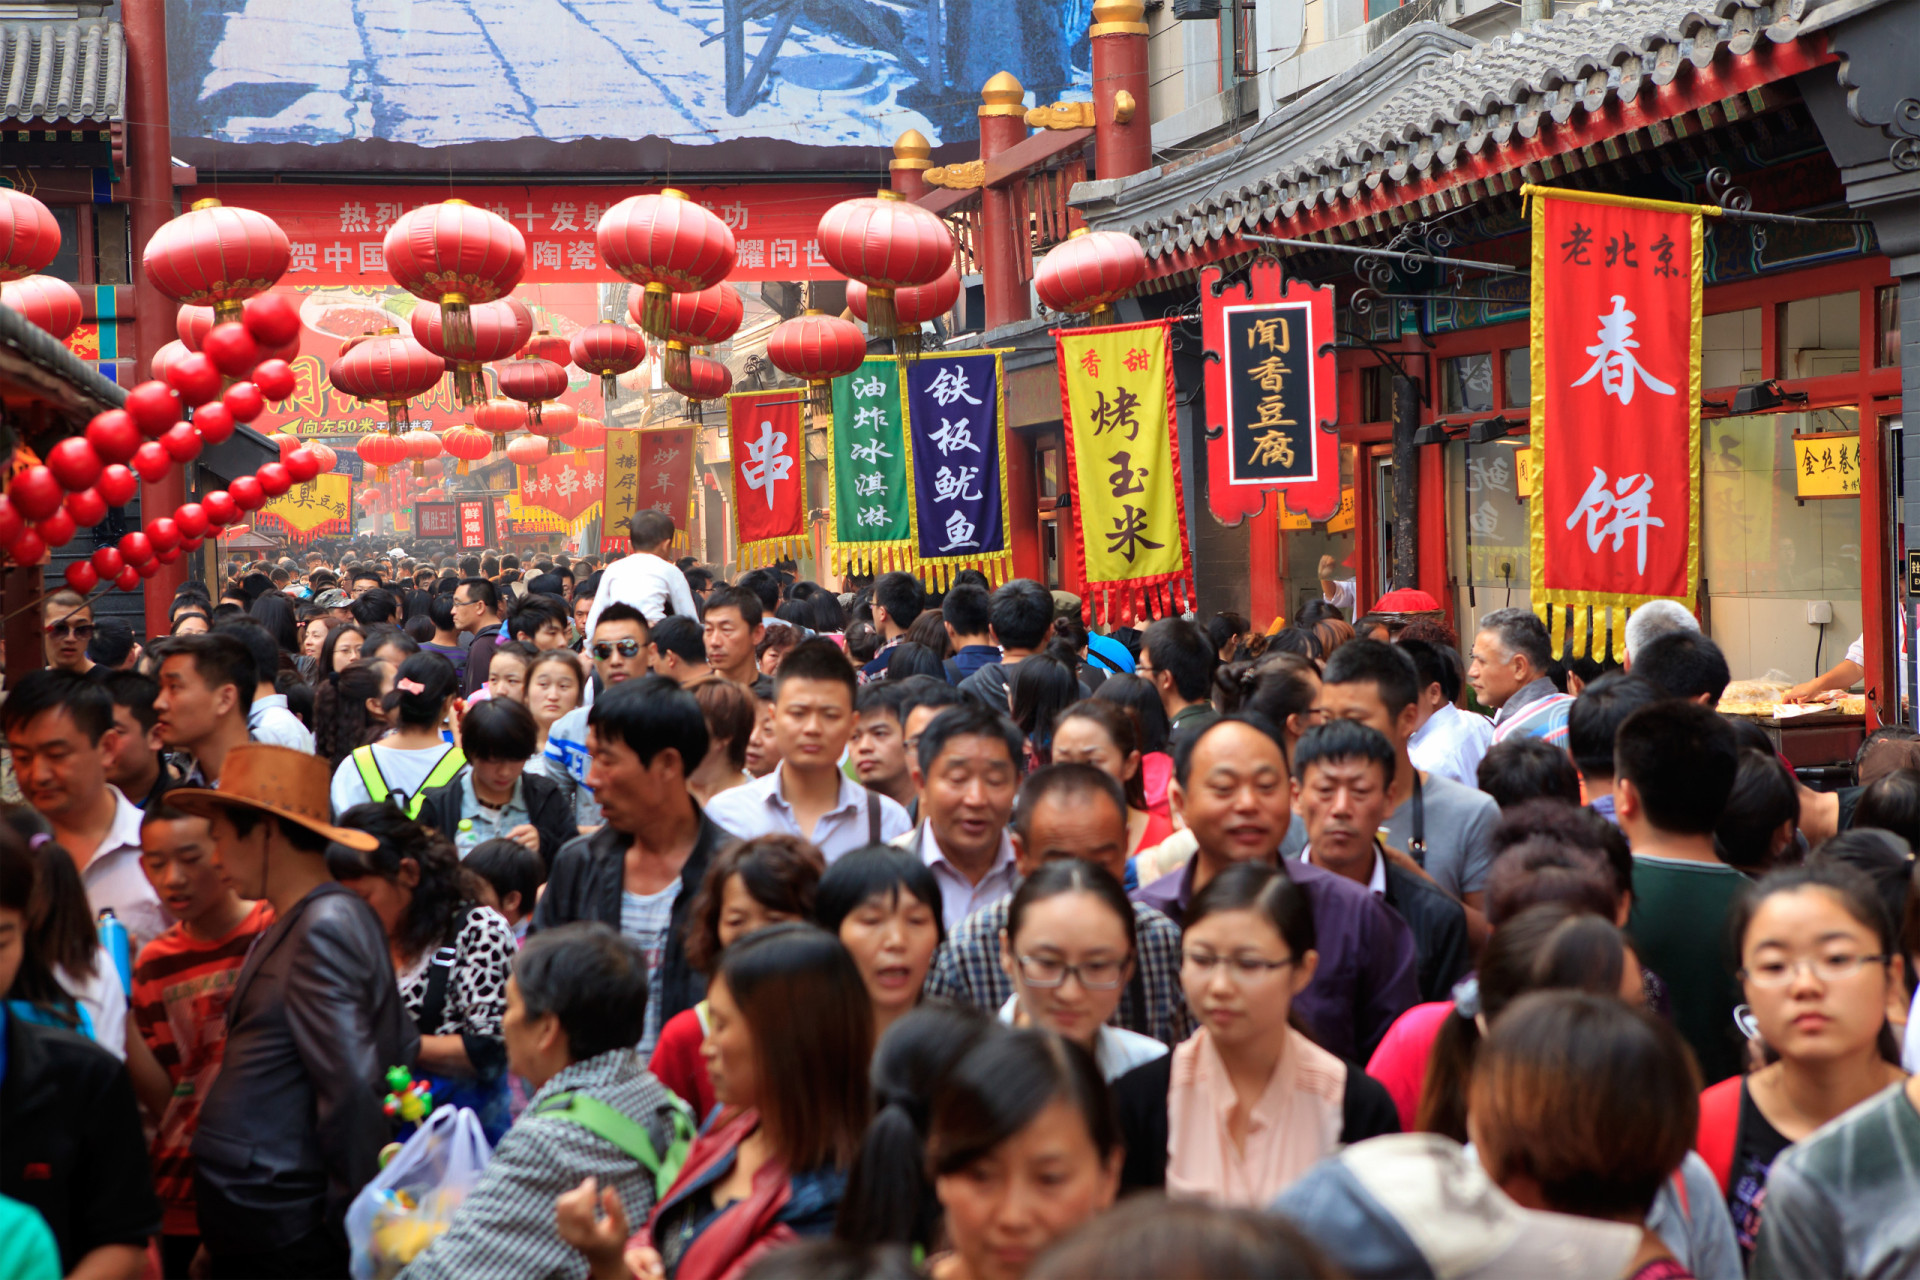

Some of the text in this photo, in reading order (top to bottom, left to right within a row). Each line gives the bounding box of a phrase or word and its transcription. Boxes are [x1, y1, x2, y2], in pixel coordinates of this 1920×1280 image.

[1561, 222, 1680, 279] 老北京
[1081, 348, 1151, 379] 香甜
[1247, 317, 1298, 469] 闻香豆腐
[1566, 295, 1677, 576] 春饼
[464, 508, 481, 546] 鲜爆肚
[741, 421, 793, 511] 串
[851, 375, 893, 527] 油炸冰淇淋
[924, 365, 983, 552] 铁板鱿鱼
[1090, 386, 1165, 563] 烤玉米
